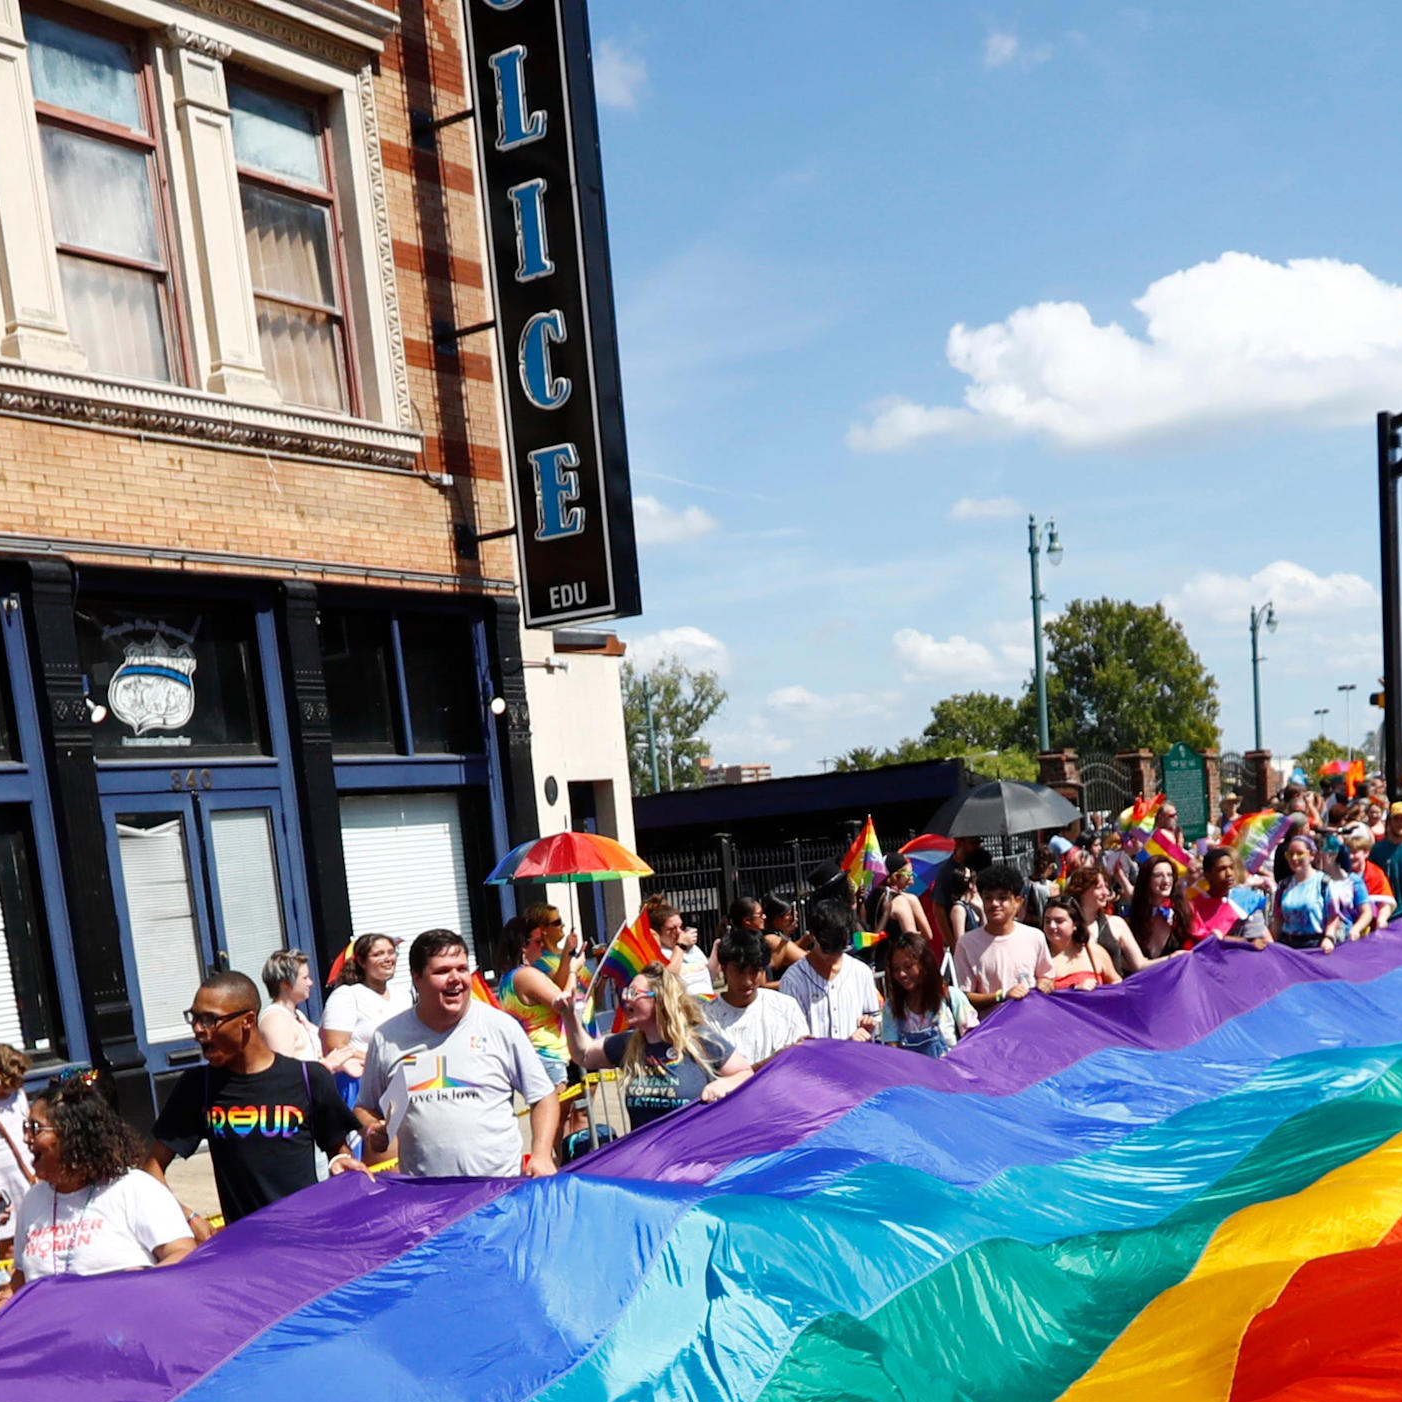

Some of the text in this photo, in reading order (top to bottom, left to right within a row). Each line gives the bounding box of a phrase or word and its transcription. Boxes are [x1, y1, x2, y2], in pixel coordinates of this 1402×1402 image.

[482, 0, 586, 542] LICE
[548, 581, 588, 610] EDU
[409, 1094, 434, 1105] ove
